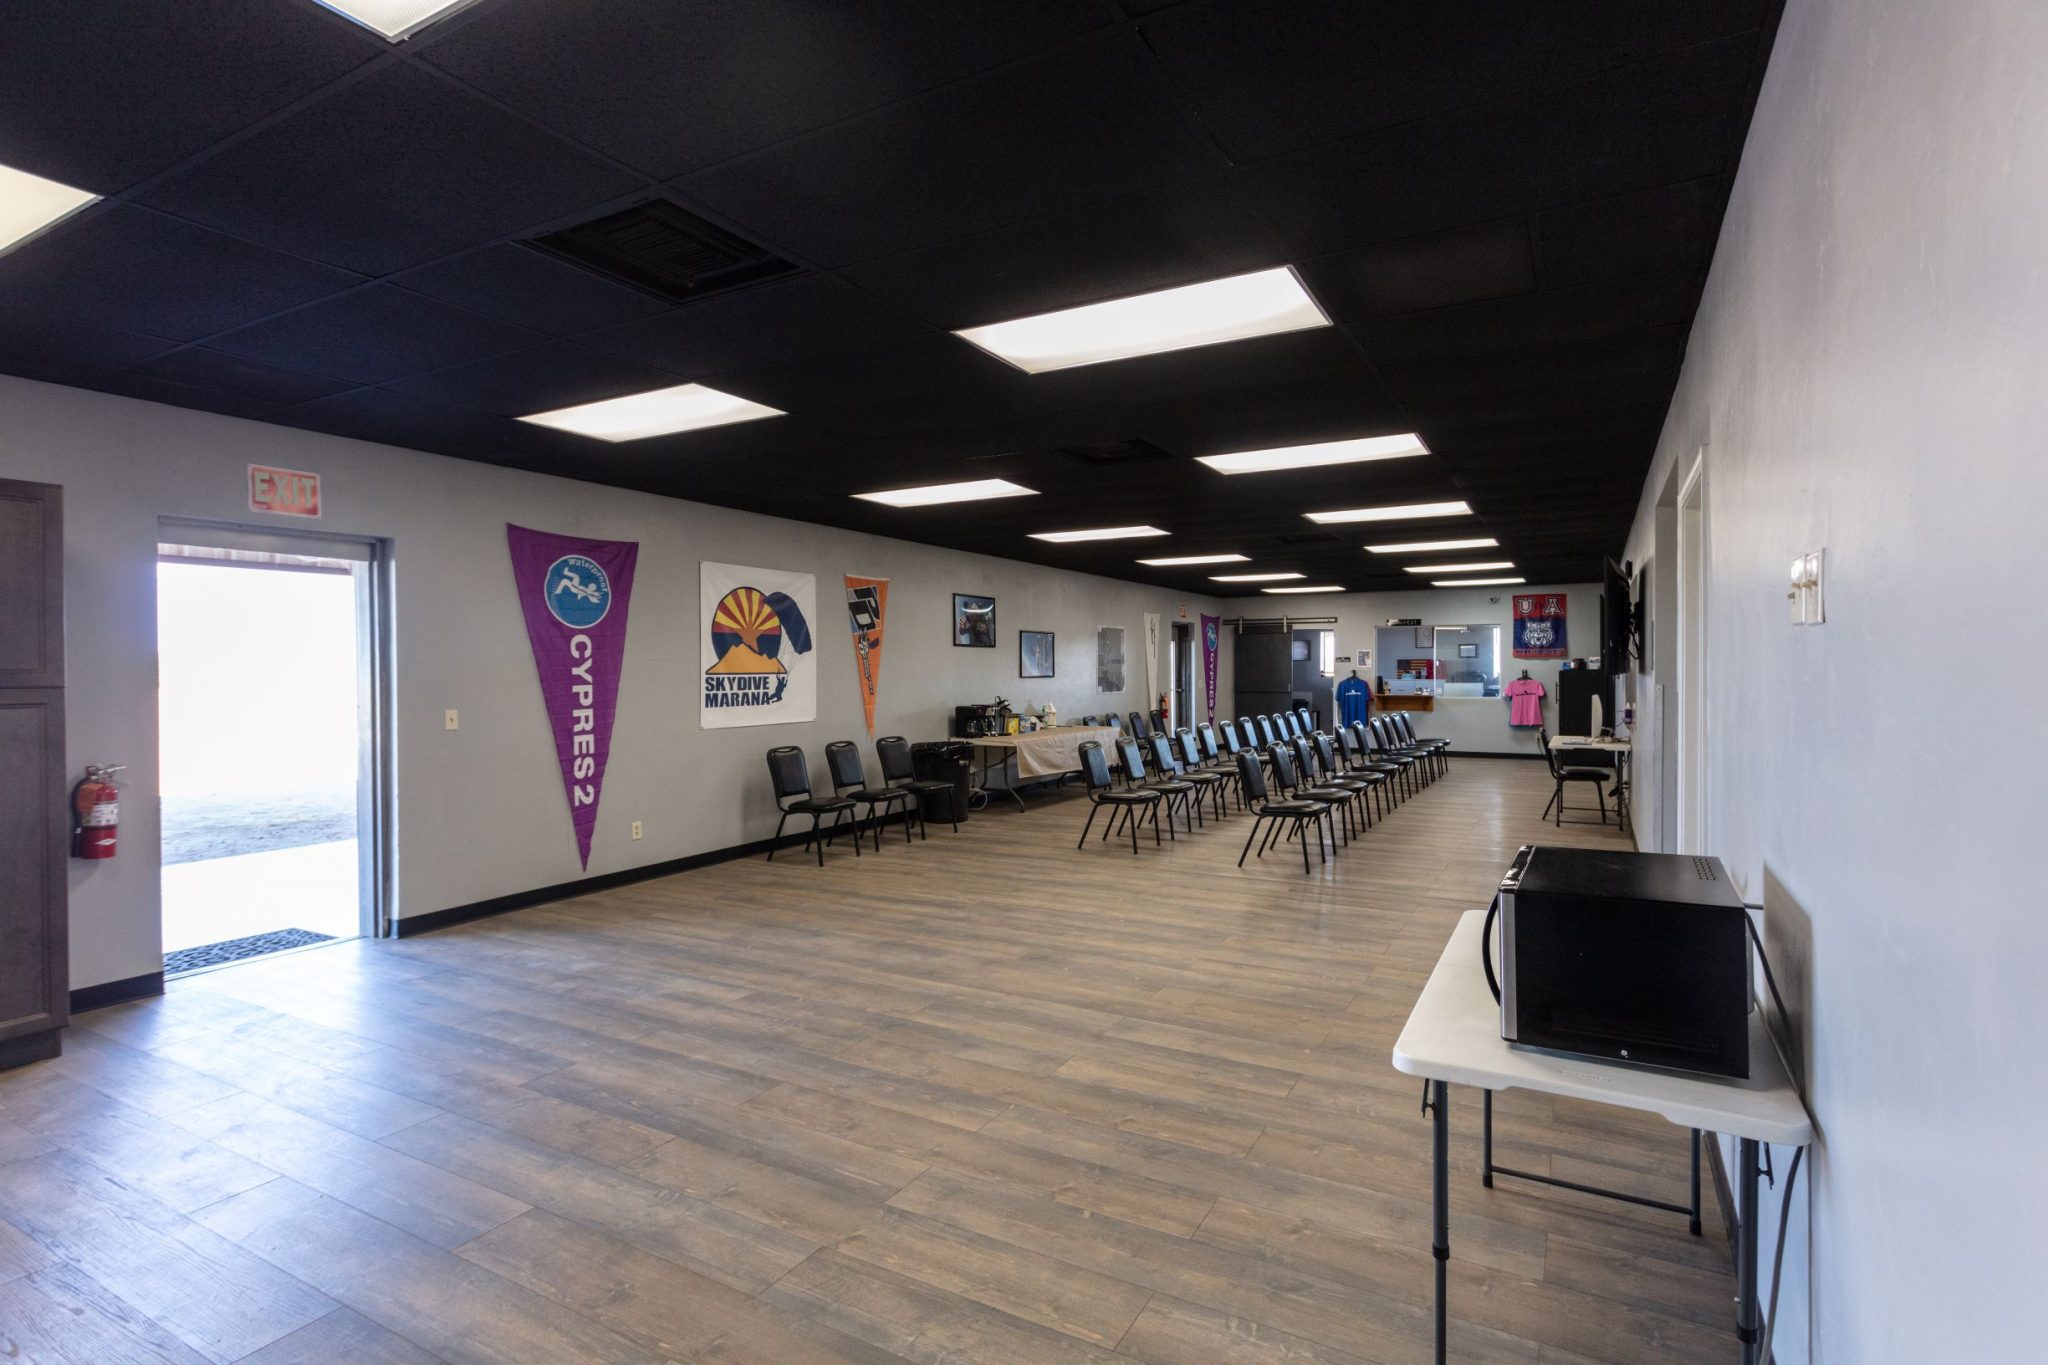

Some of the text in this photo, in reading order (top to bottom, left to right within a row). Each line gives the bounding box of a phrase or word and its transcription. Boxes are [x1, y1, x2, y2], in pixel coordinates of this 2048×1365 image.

[255, 472, 316, 508] EXIT
[705, 676, 770, 692] SKYDIVE
[705, 691, 771, 708] MARANA
[570, 634, 595, 807] CYPRES 2
